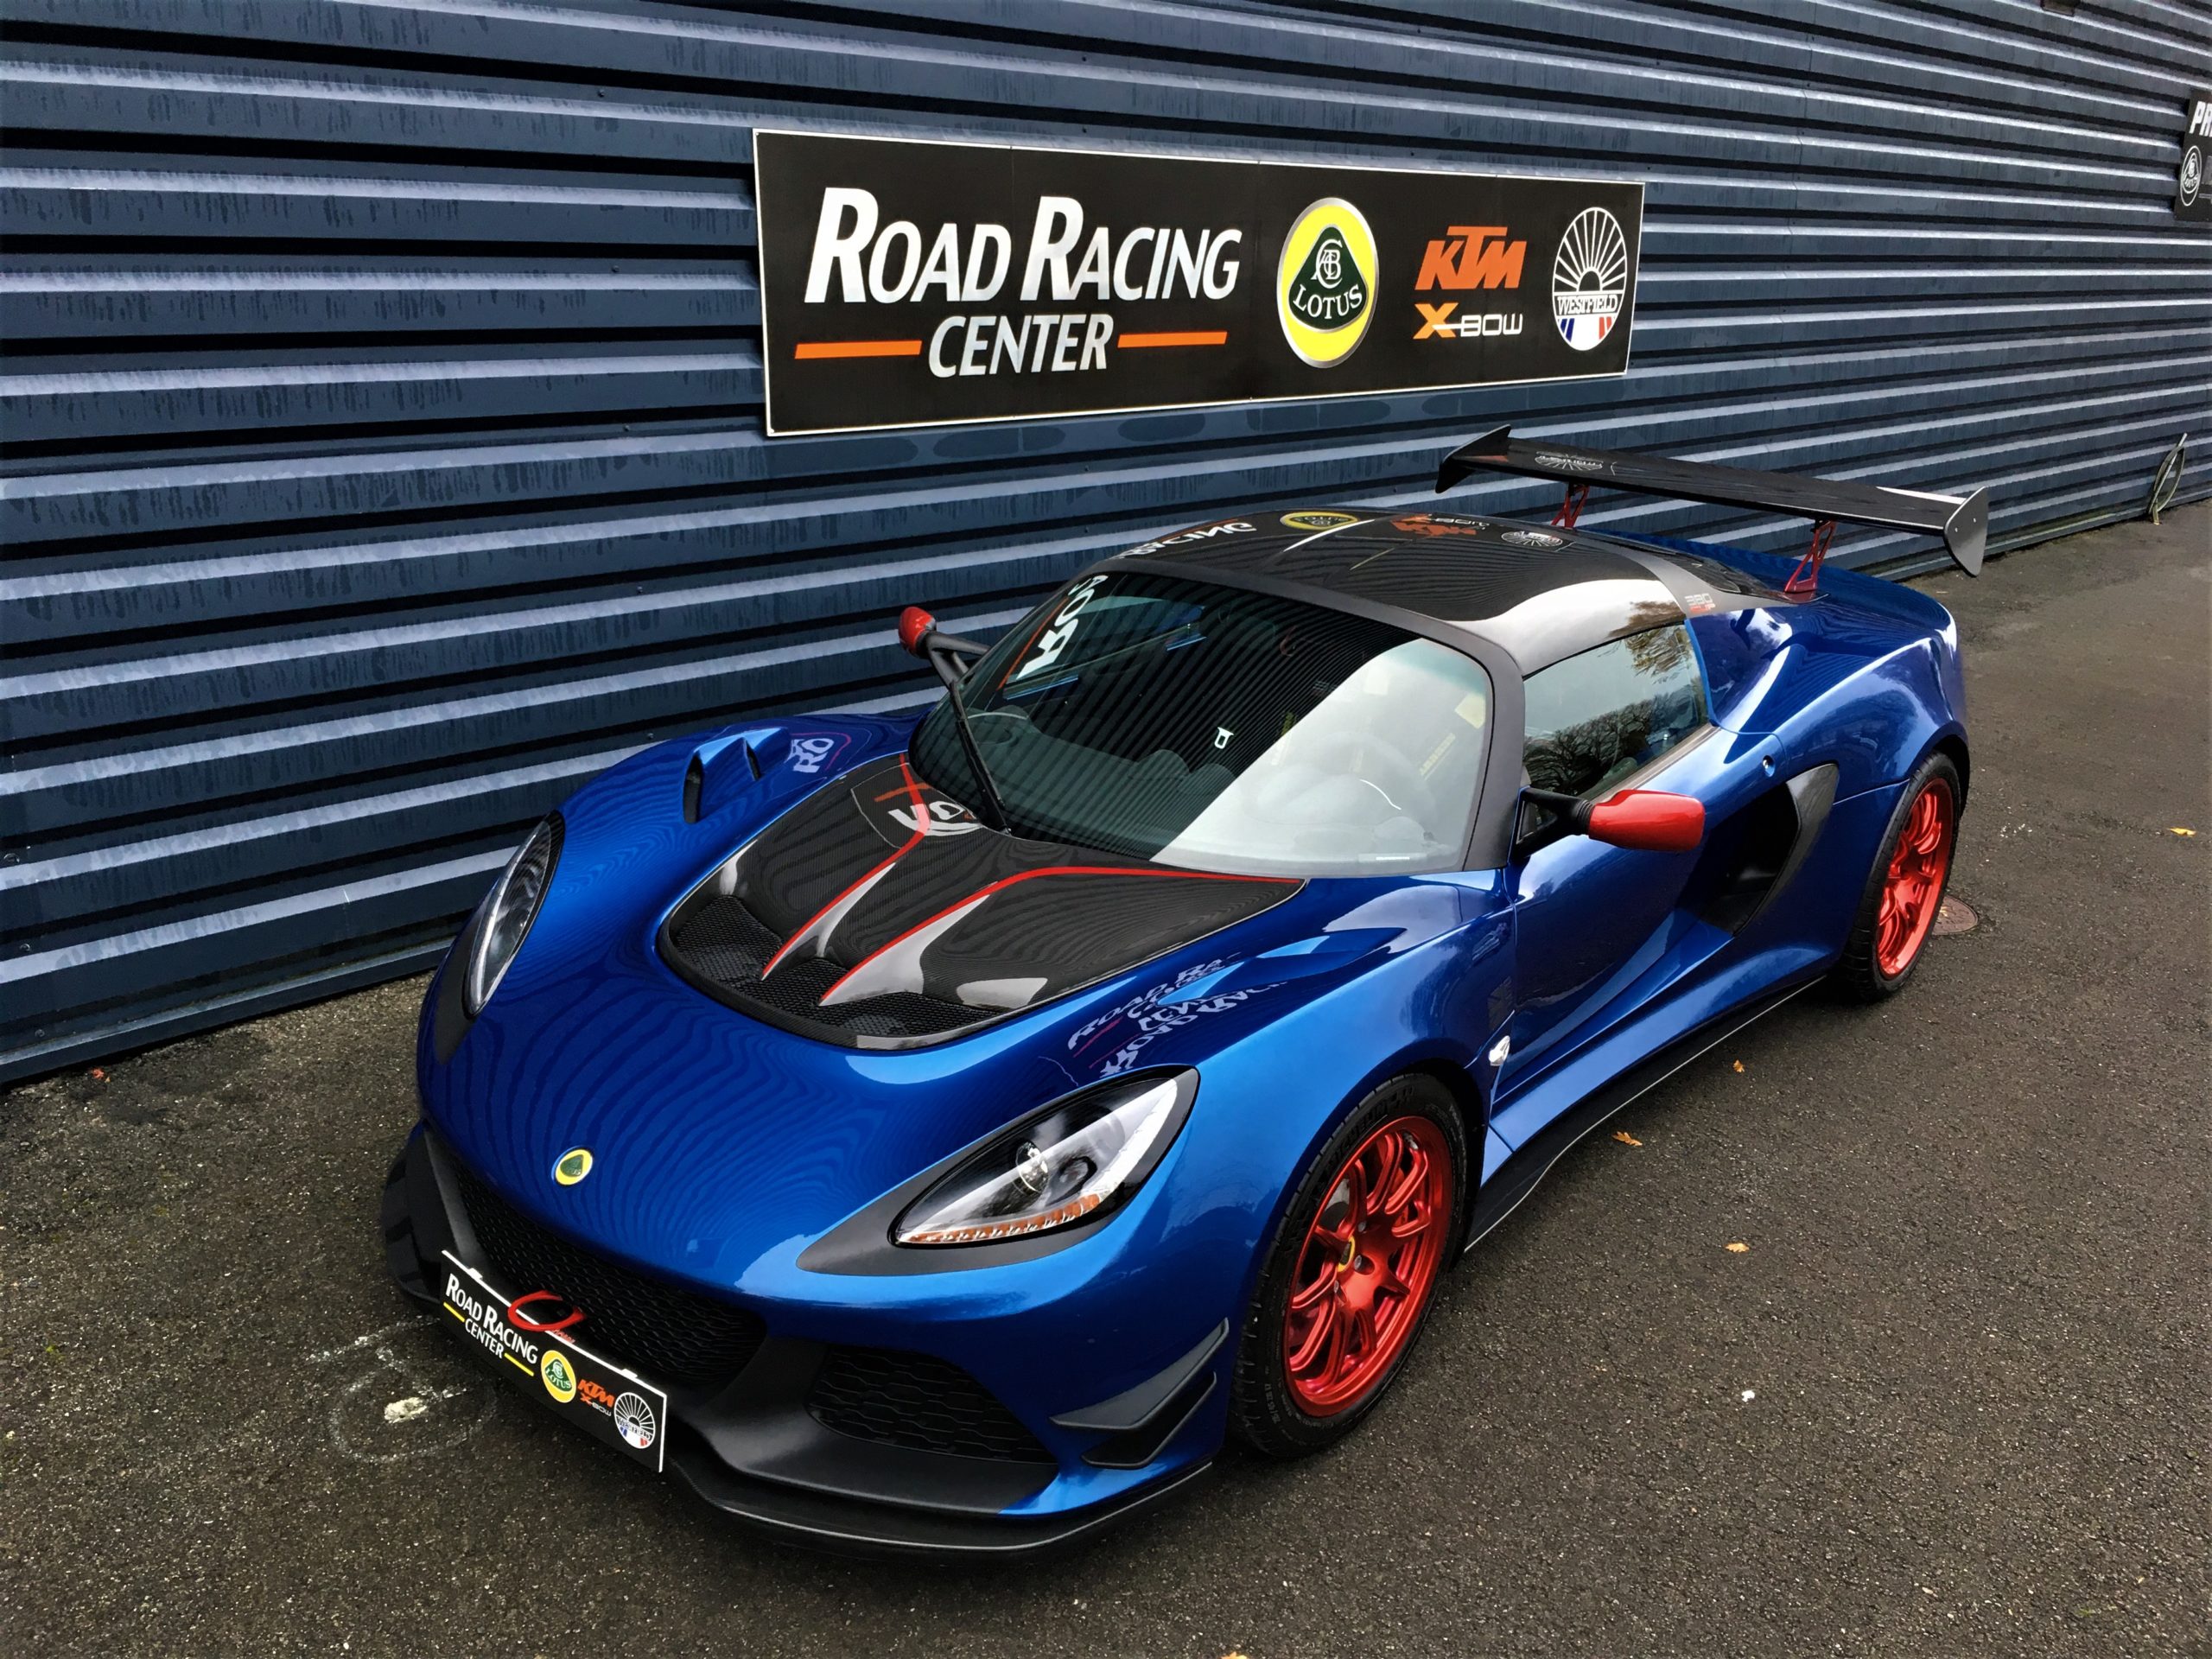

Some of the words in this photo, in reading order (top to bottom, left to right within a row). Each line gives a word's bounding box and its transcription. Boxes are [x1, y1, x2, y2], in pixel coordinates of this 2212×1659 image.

[804, 187, 1012, 304] ROAD
[1020, 195, 1243, 302] RACING
[1414, 226, 1528, 290] KTM
[1293, 283, 1363, 321] LOTUS
[1556, 295, 1619, 315] WESTFIELD
[928, 313, 1115, 378] CENTER
[445, 1273, 483, 1319] ROAD
[484, 1305, 538, 1364] RACING
[464, 1317, 505, 1359] CENTER
[544, 1368, 572, 1389] LOTUS
[577, 1379, 615, 1408] KTM
